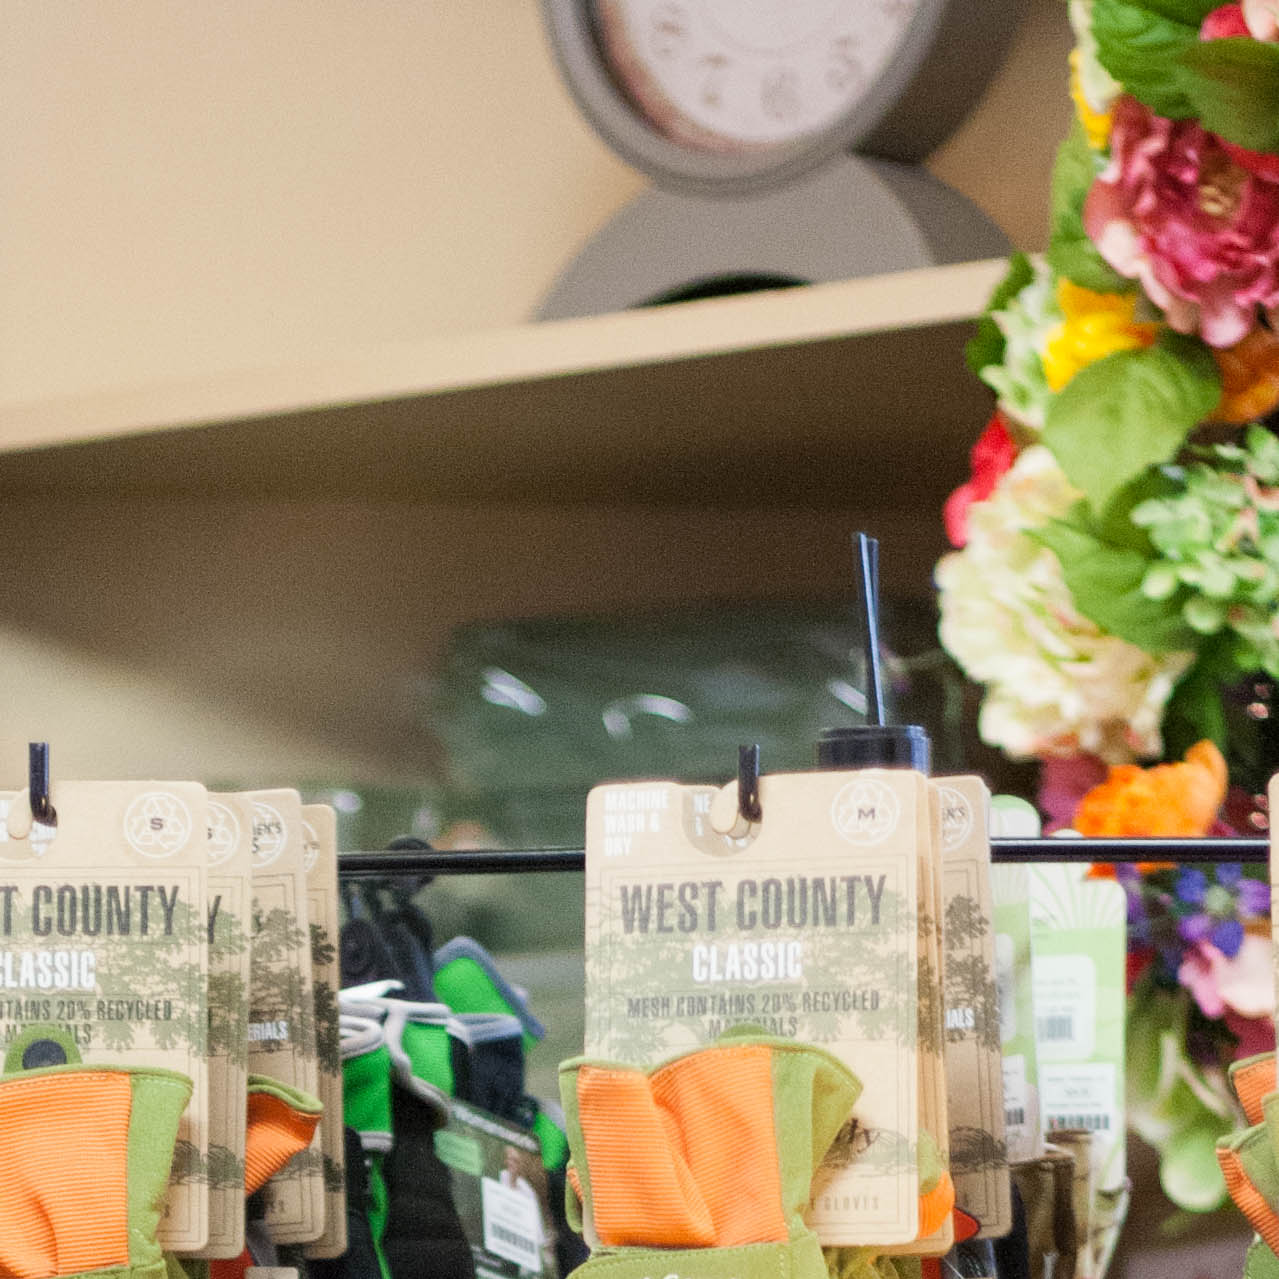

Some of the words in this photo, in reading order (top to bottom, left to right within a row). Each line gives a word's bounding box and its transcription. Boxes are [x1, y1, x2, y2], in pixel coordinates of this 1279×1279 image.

[150, 817, 164, 831] S
[857, 808, 875, 819] M
[32, 885, 180, 937] COUNTY
[621, 880, 723, 935] WEST
[736, 874, 887, 931] COUNTY
[691, 942, 803, 982] CLASSIC
[57, 1000, 90, 1021] 20%
[97, 999, 173, 1021] RECYCLED
[627, 997, 670, 1018] MESH
[676, 993, 756, 1017] CONTAINS
[761, 993, 796, 1014] 20%
[802, 990, 880, 1013] RECYCLED
